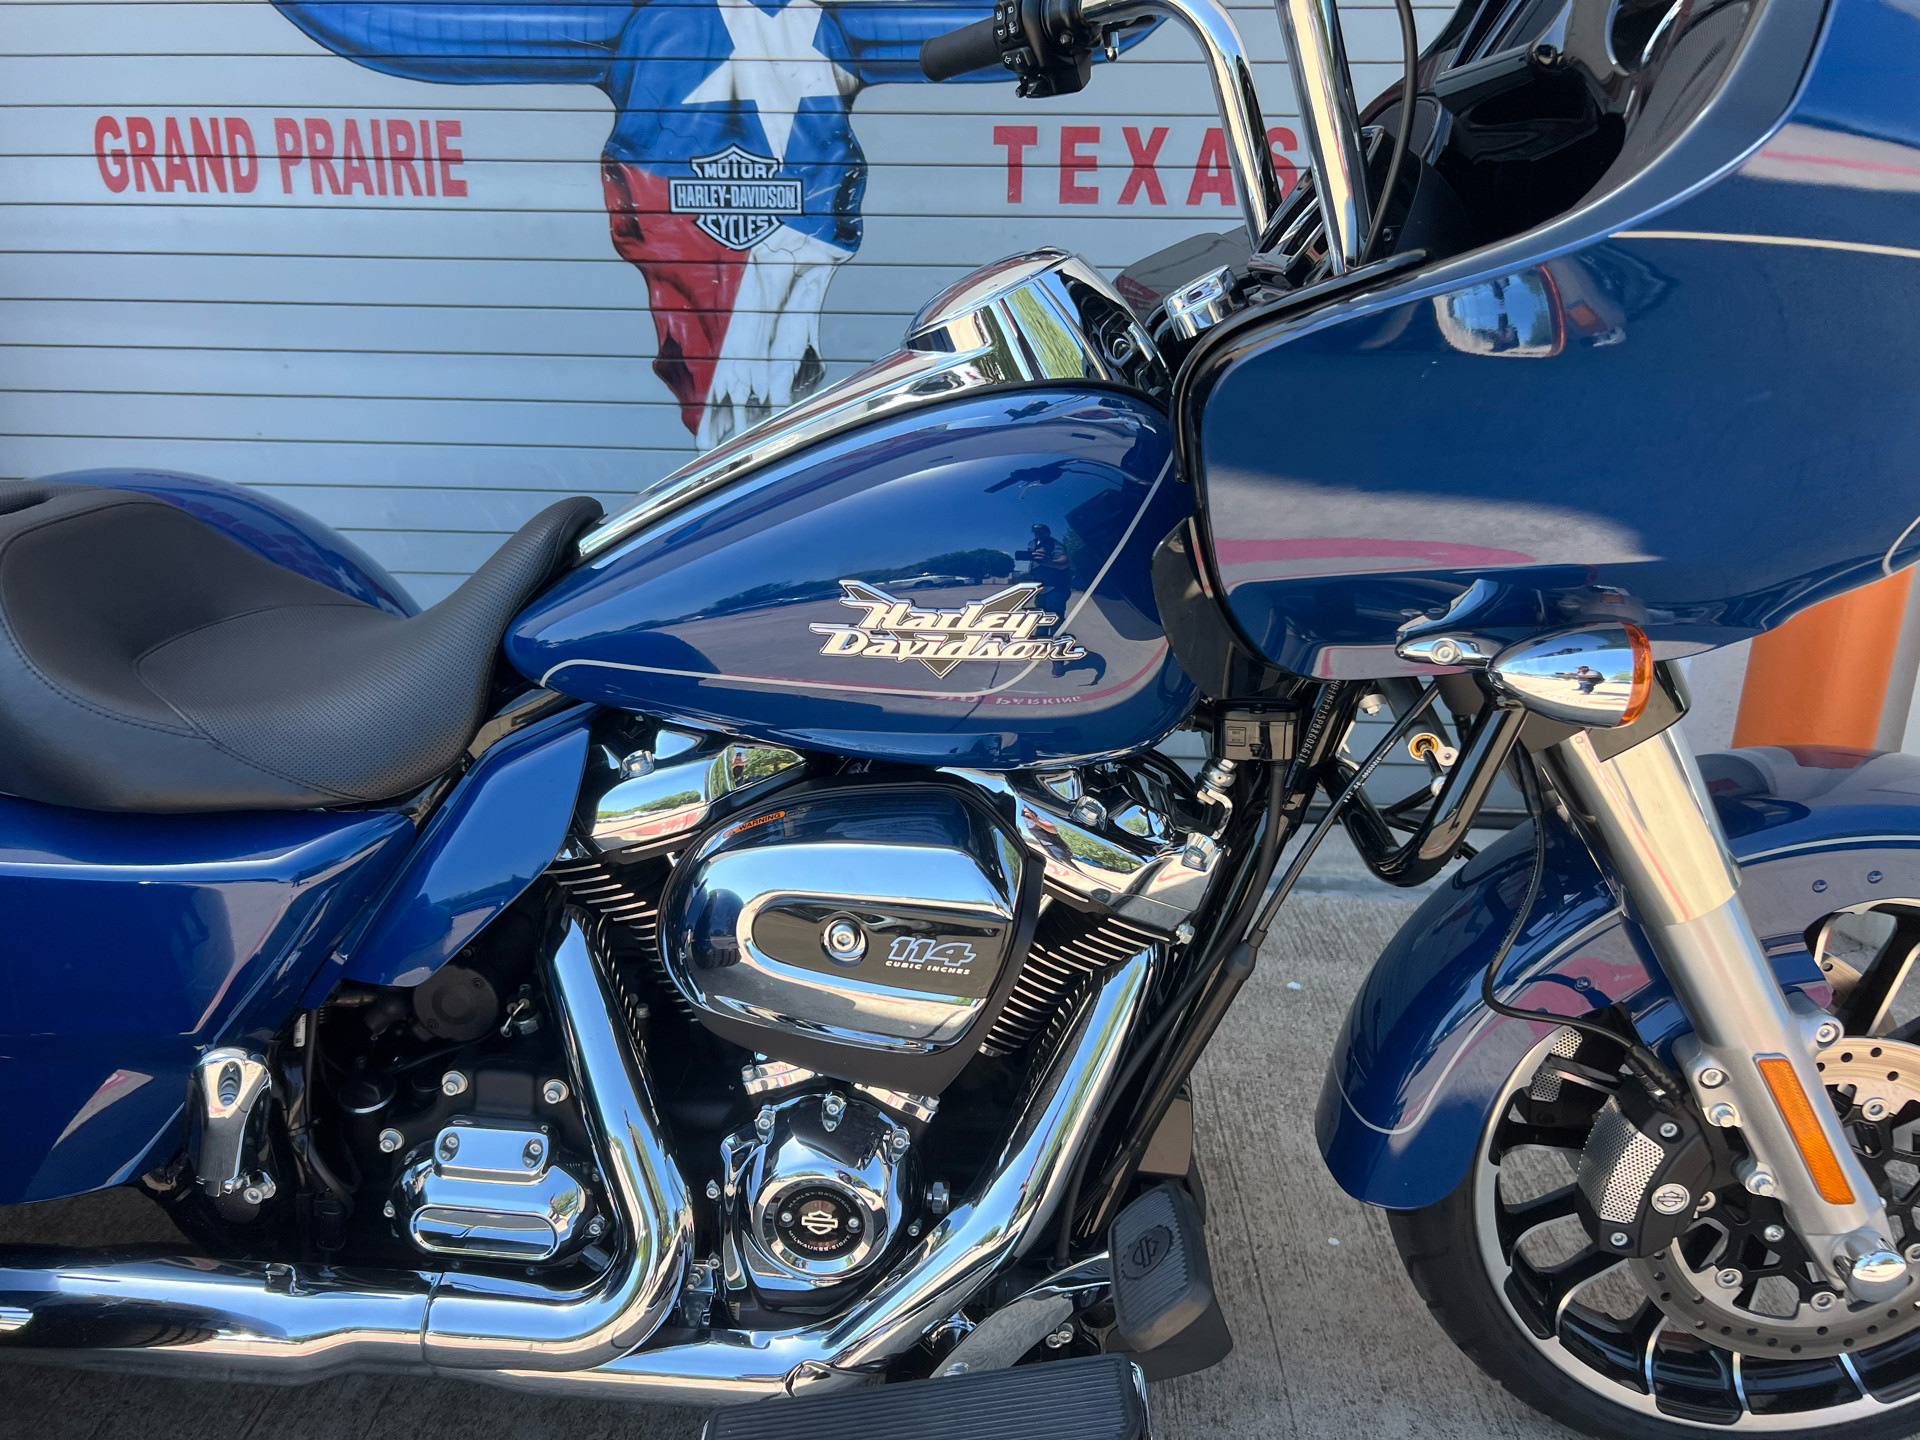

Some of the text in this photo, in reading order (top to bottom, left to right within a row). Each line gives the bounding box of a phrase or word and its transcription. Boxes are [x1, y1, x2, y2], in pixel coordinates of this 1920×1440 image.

[94, 115, 468, 197] GRAND PRAIRIE
[703, 152, 768, 179] MOTOR
[676, 184, 796, 209] HARLEY-DAVIDSON
[706, 215, 770, 244] CYCLES
[808, 622, 1088, 662] Davidson
[738, 812, 781, 831] WARNING
[888, 936, 977, 967] 114
[885, 960, 971, 975] CUBIC INCHES
